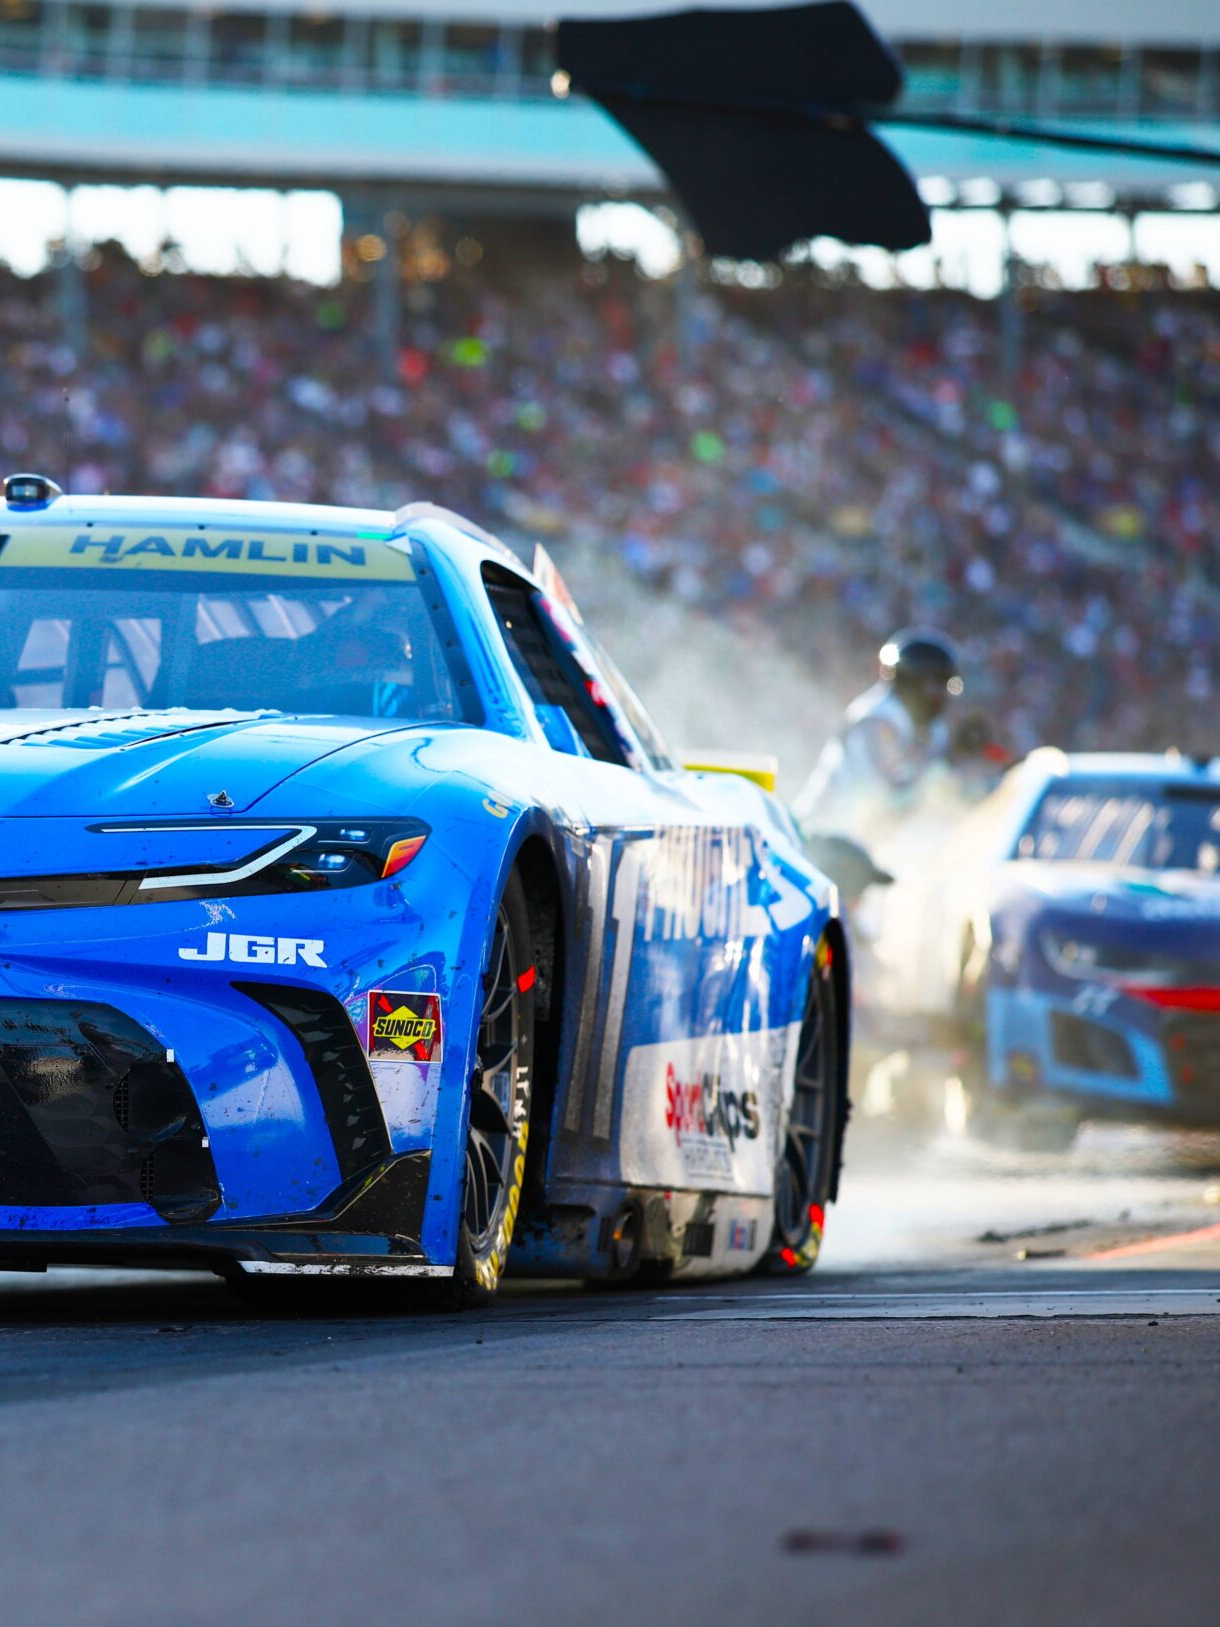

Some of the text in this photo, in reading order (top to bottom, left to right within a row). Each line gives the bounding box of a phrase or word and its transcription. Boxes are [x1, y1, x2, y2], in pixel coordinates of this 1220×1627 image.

[68, 534, 367, 567] HAMLIN
[177, 931, 329, 969] JGR
[374, 1017, 435, 1038] SUNOCO
